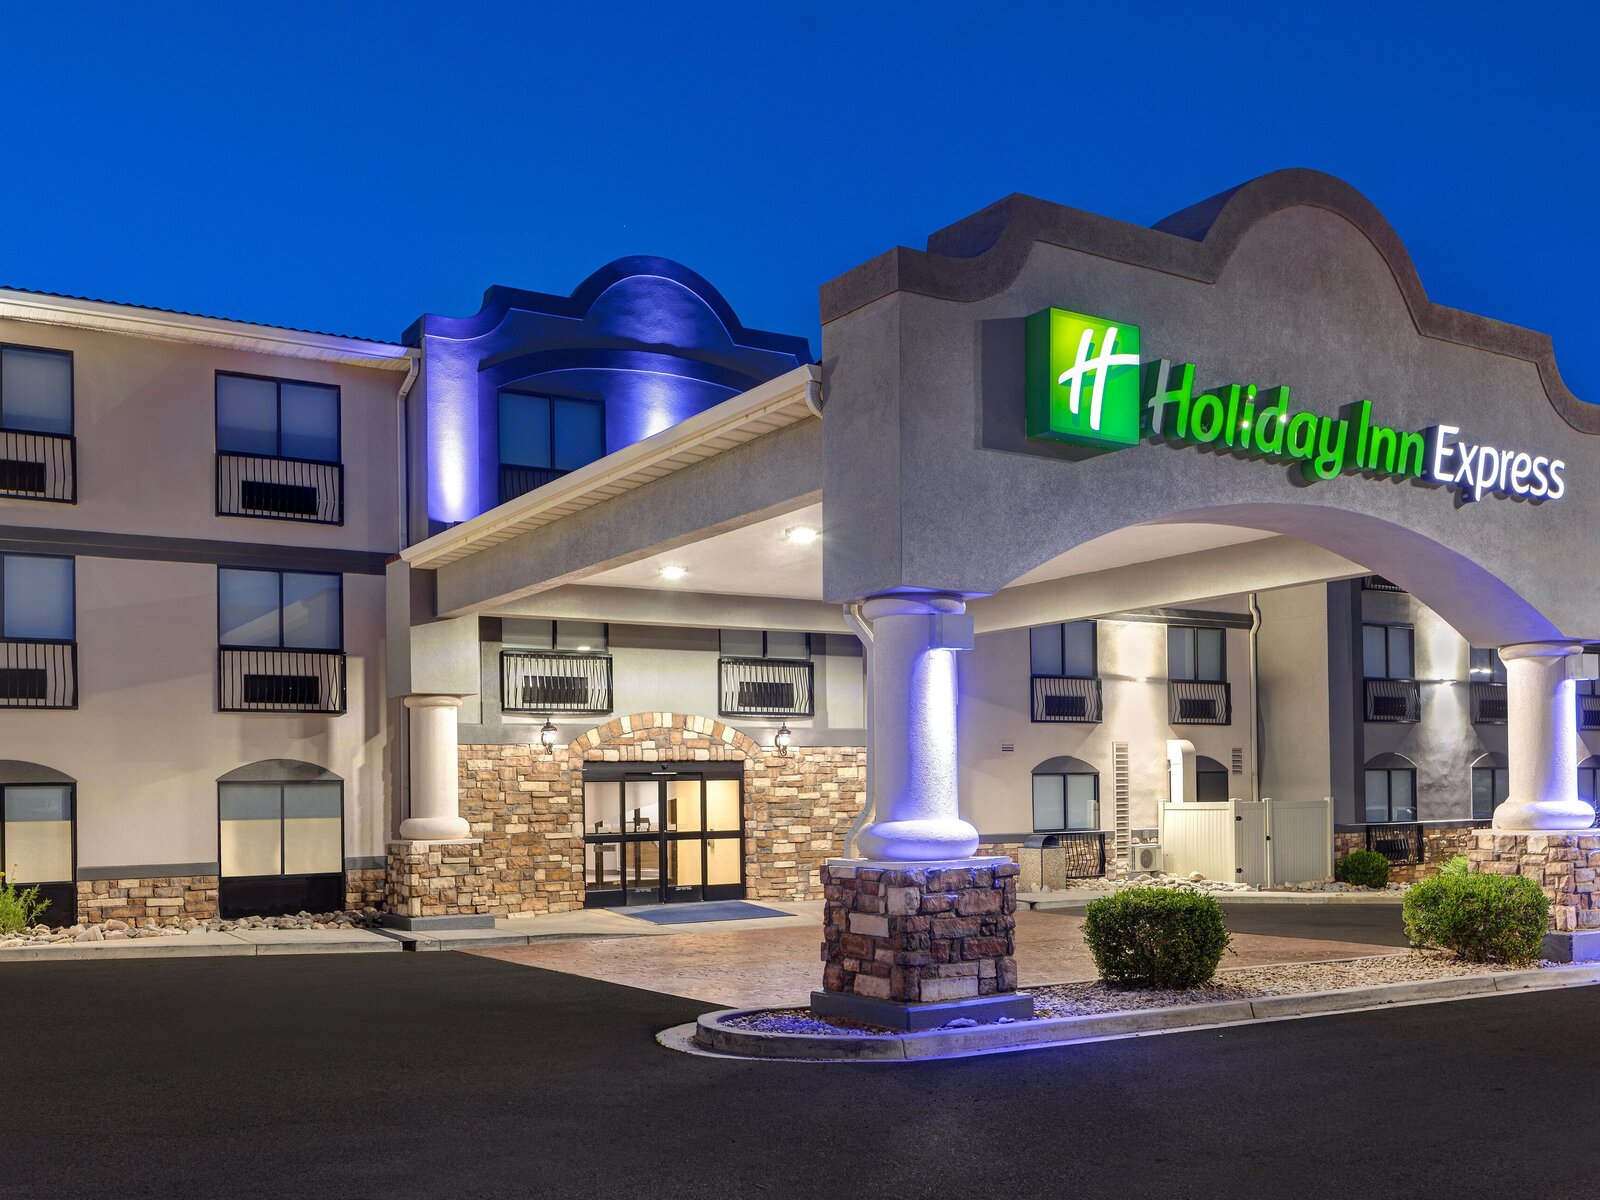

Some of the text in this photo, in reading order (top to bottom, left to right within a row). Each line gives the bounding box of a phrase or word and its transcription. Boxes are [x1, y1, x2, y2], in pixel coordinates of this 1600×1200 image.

[1148, 358, 1566, 502] Holiday Inn Express
